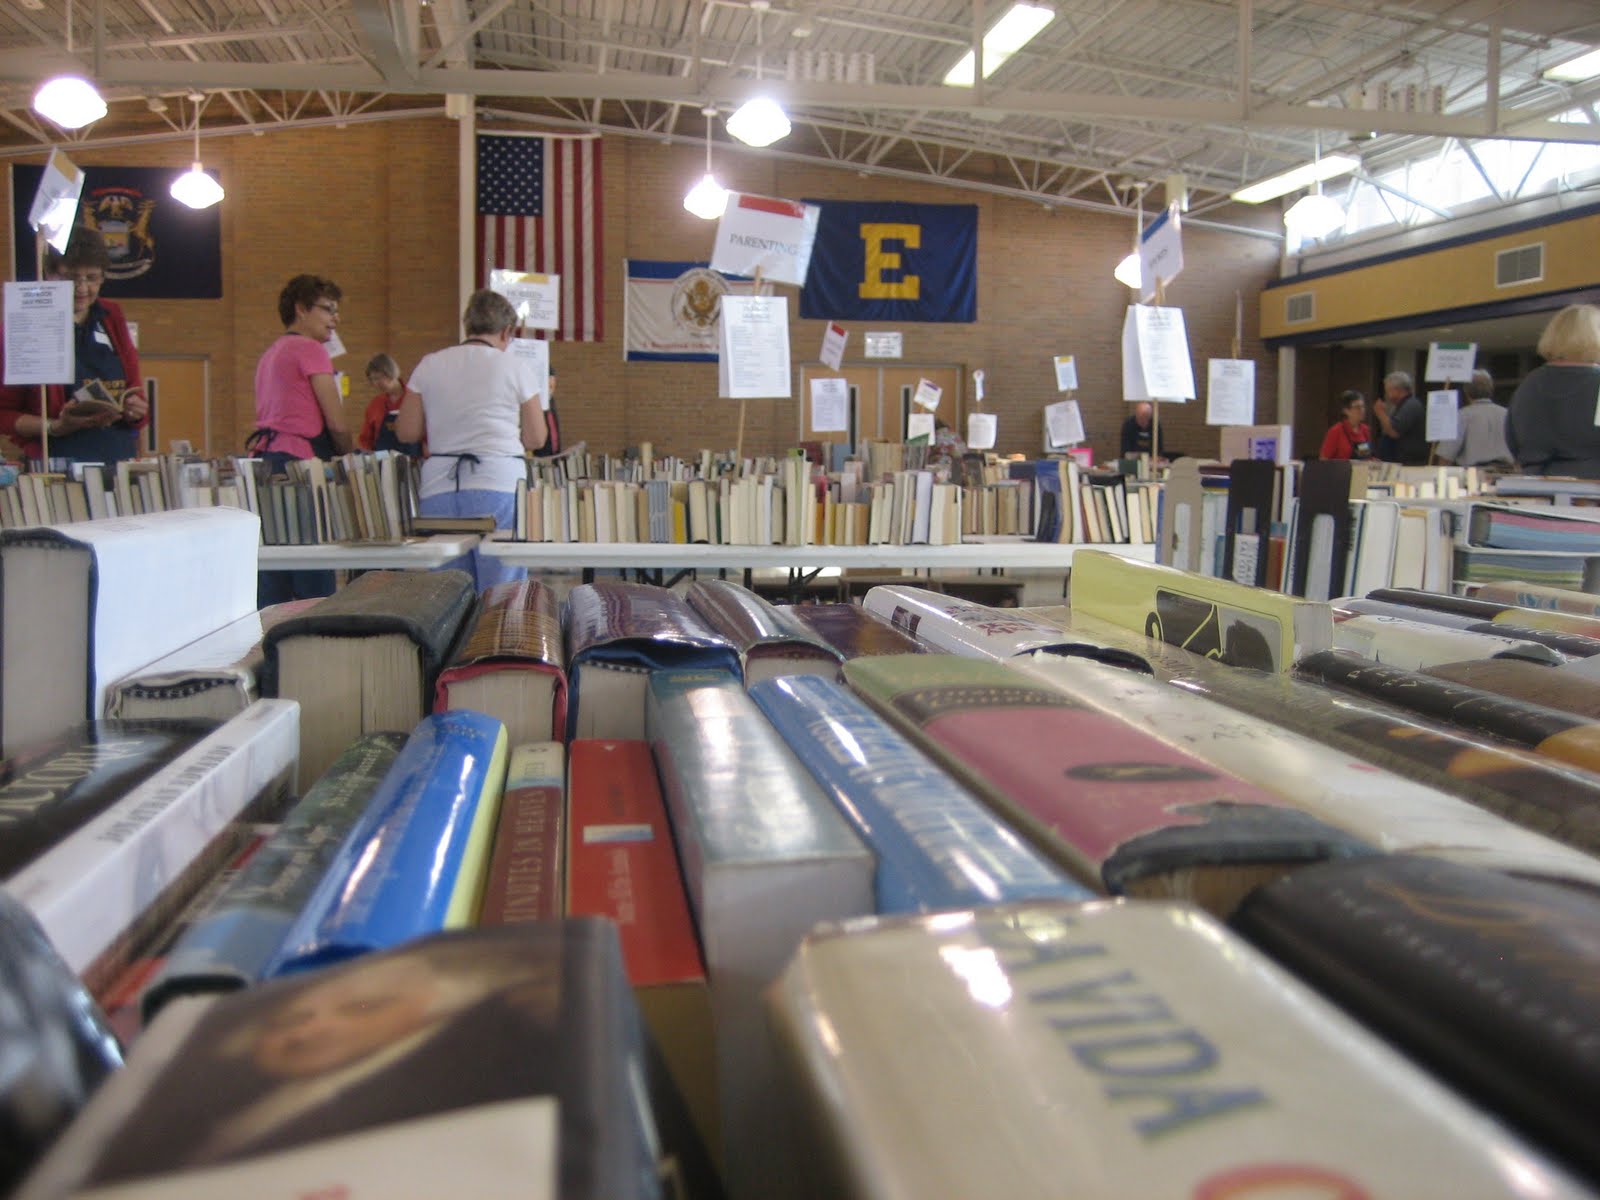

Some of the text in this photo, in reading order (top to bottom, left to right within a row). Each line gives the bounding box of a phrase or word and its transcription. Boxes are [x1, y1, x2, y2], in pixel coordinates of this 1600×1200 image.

[730, 232, 799, 255] PARENTING
[859, 223, 921, 300] E
[503, 856, 542, 926] INUTES
